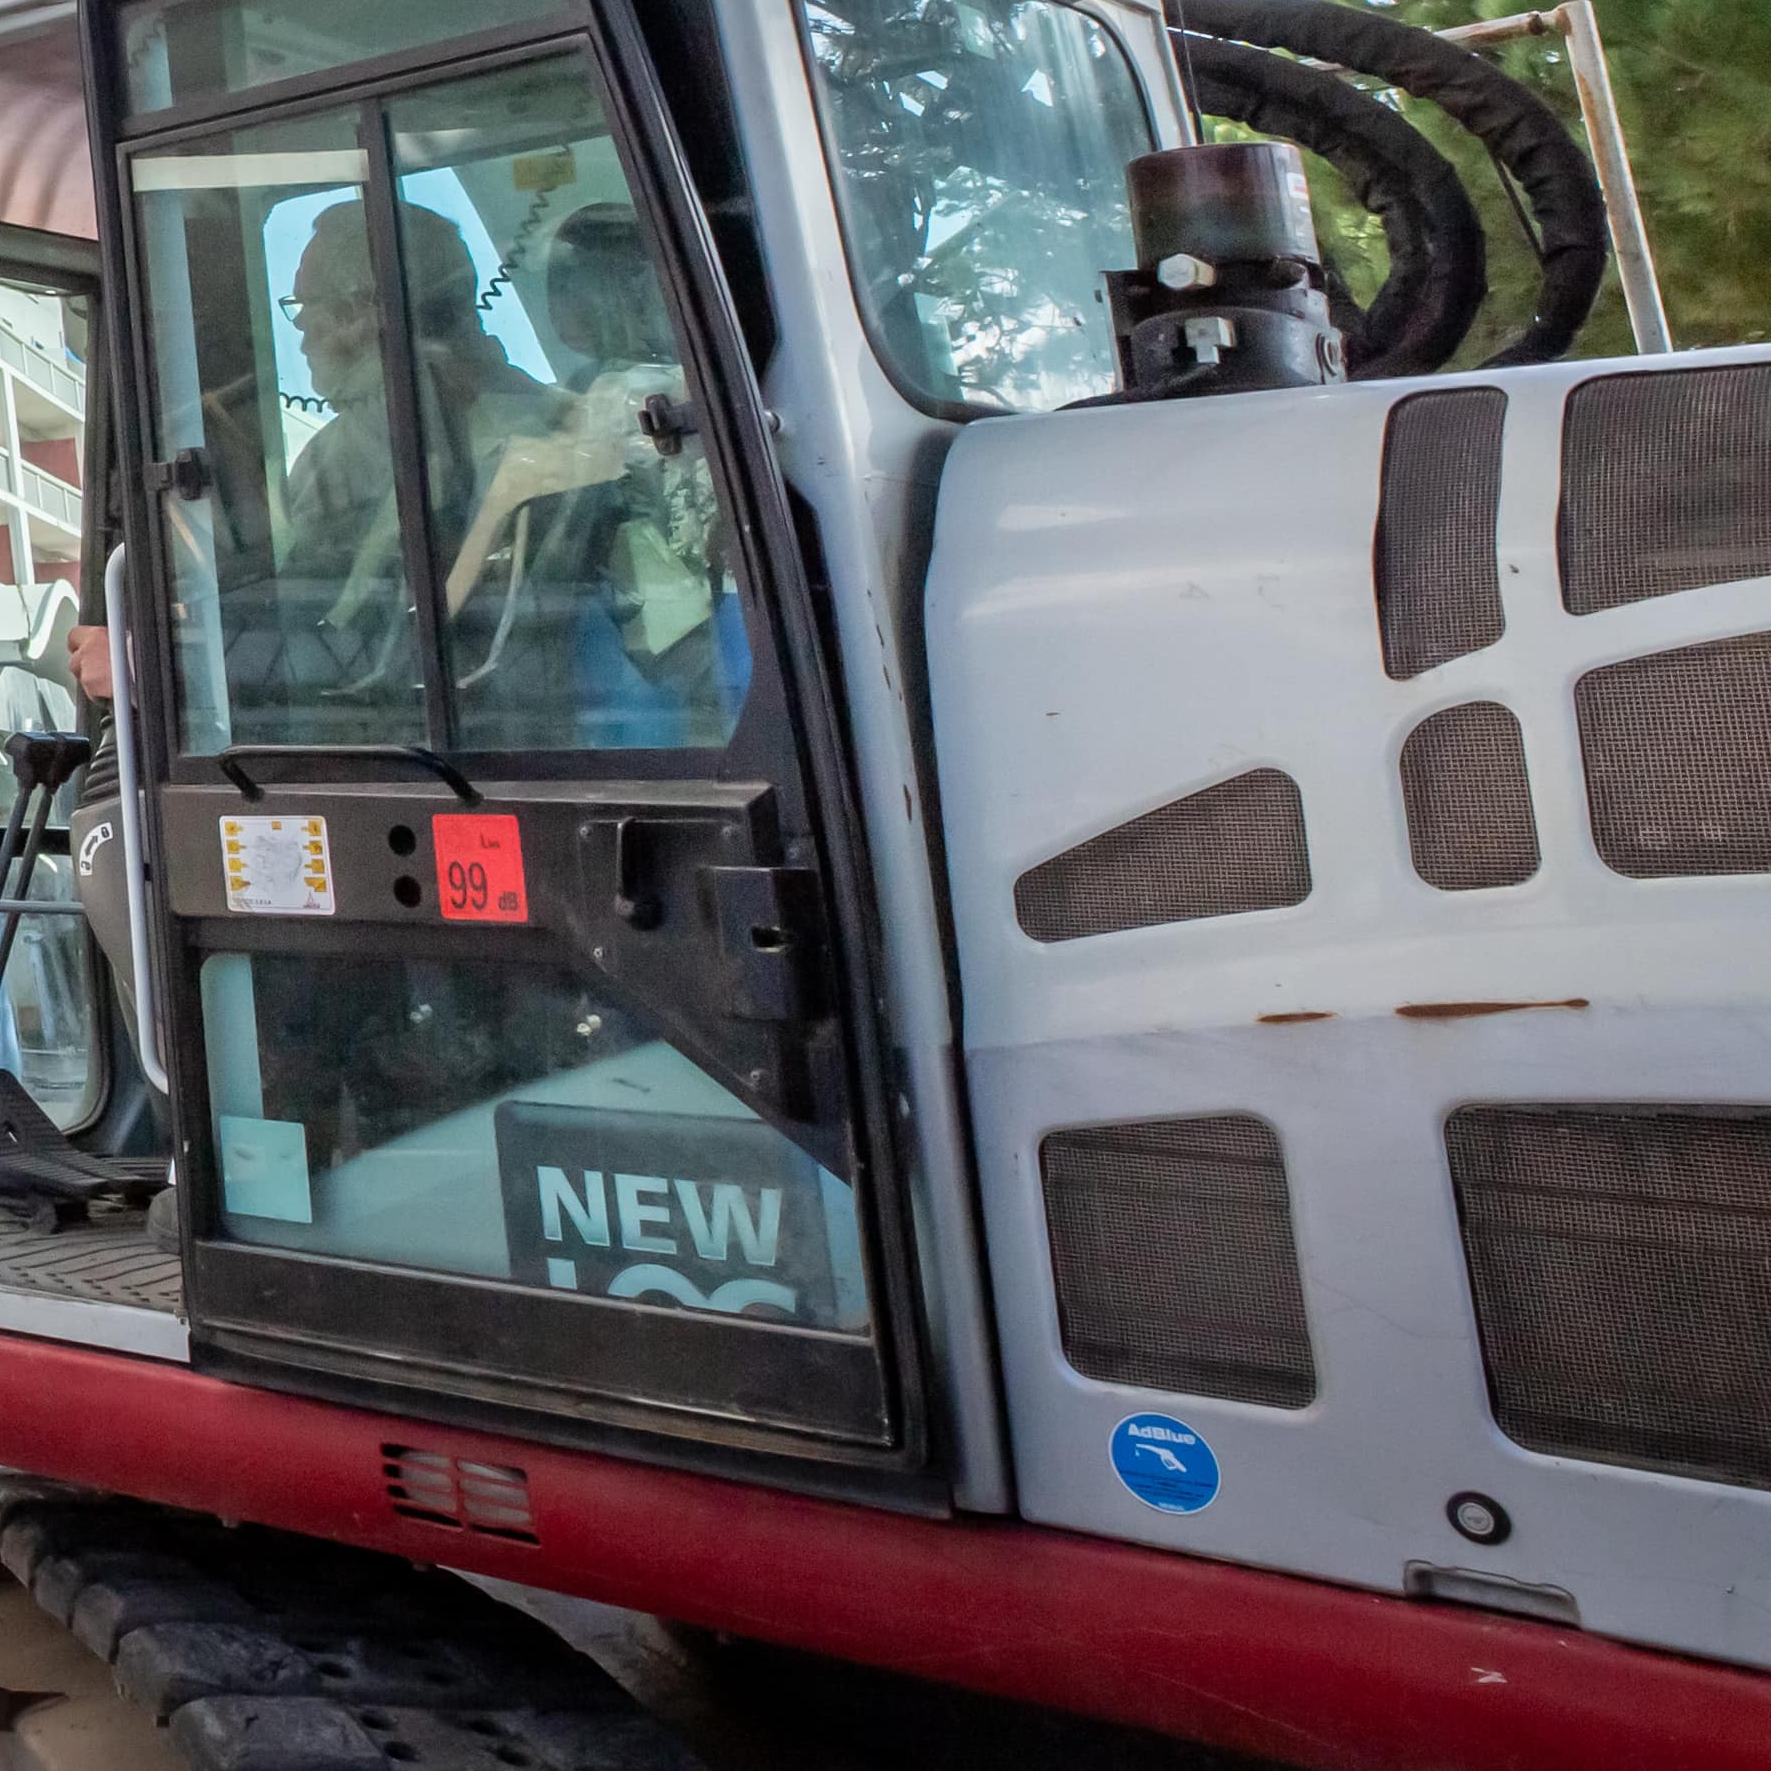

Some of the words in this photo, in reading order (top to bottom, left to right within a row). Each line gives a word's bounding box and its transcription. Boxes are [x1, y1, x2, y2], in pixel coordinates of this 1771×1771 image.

[448, 860, 488, 910] 99
[536, 1165, 782, 1267] NEW
[1128, 1423, 1195, 1445] AdBlue
